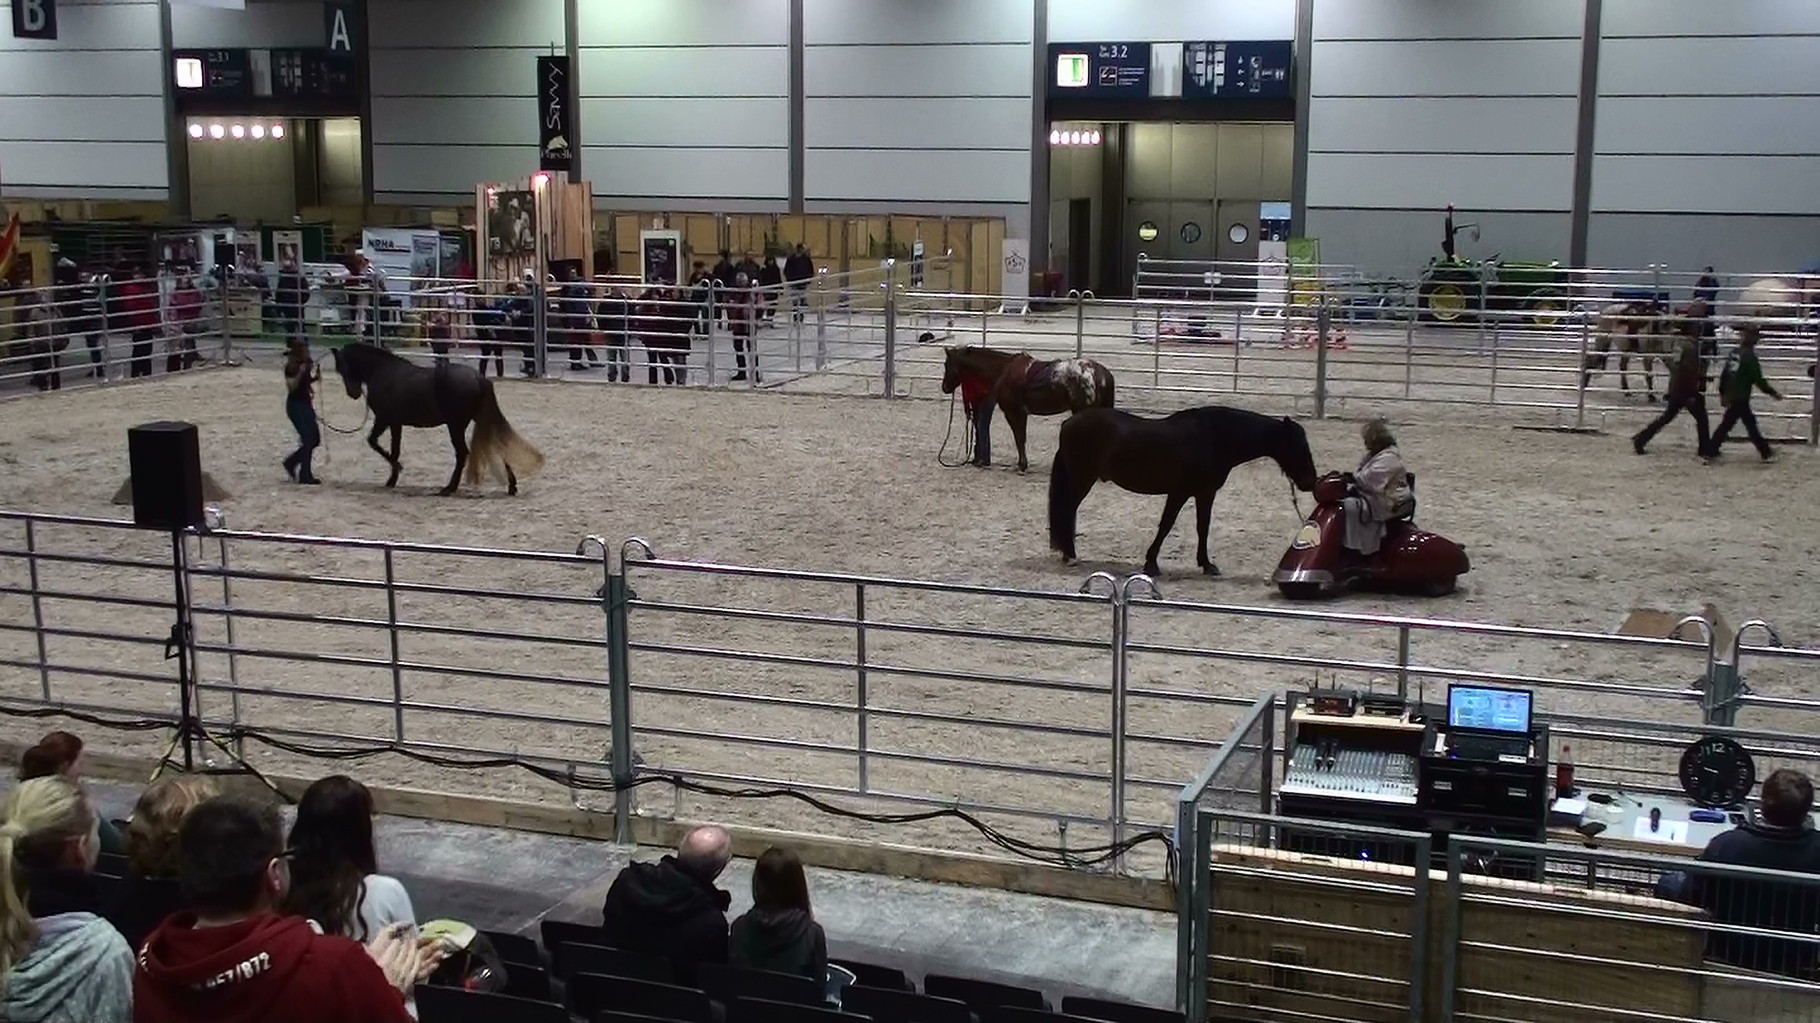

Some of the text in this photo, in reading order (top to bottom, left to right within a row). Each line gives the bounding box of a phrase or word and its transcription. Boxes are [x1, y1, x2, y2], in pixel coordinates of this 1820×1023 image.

[331, 7, 351, 51] A
[1111, 45, 1128, 59] 3.2
[1712, 743, 1725, 753] 12
